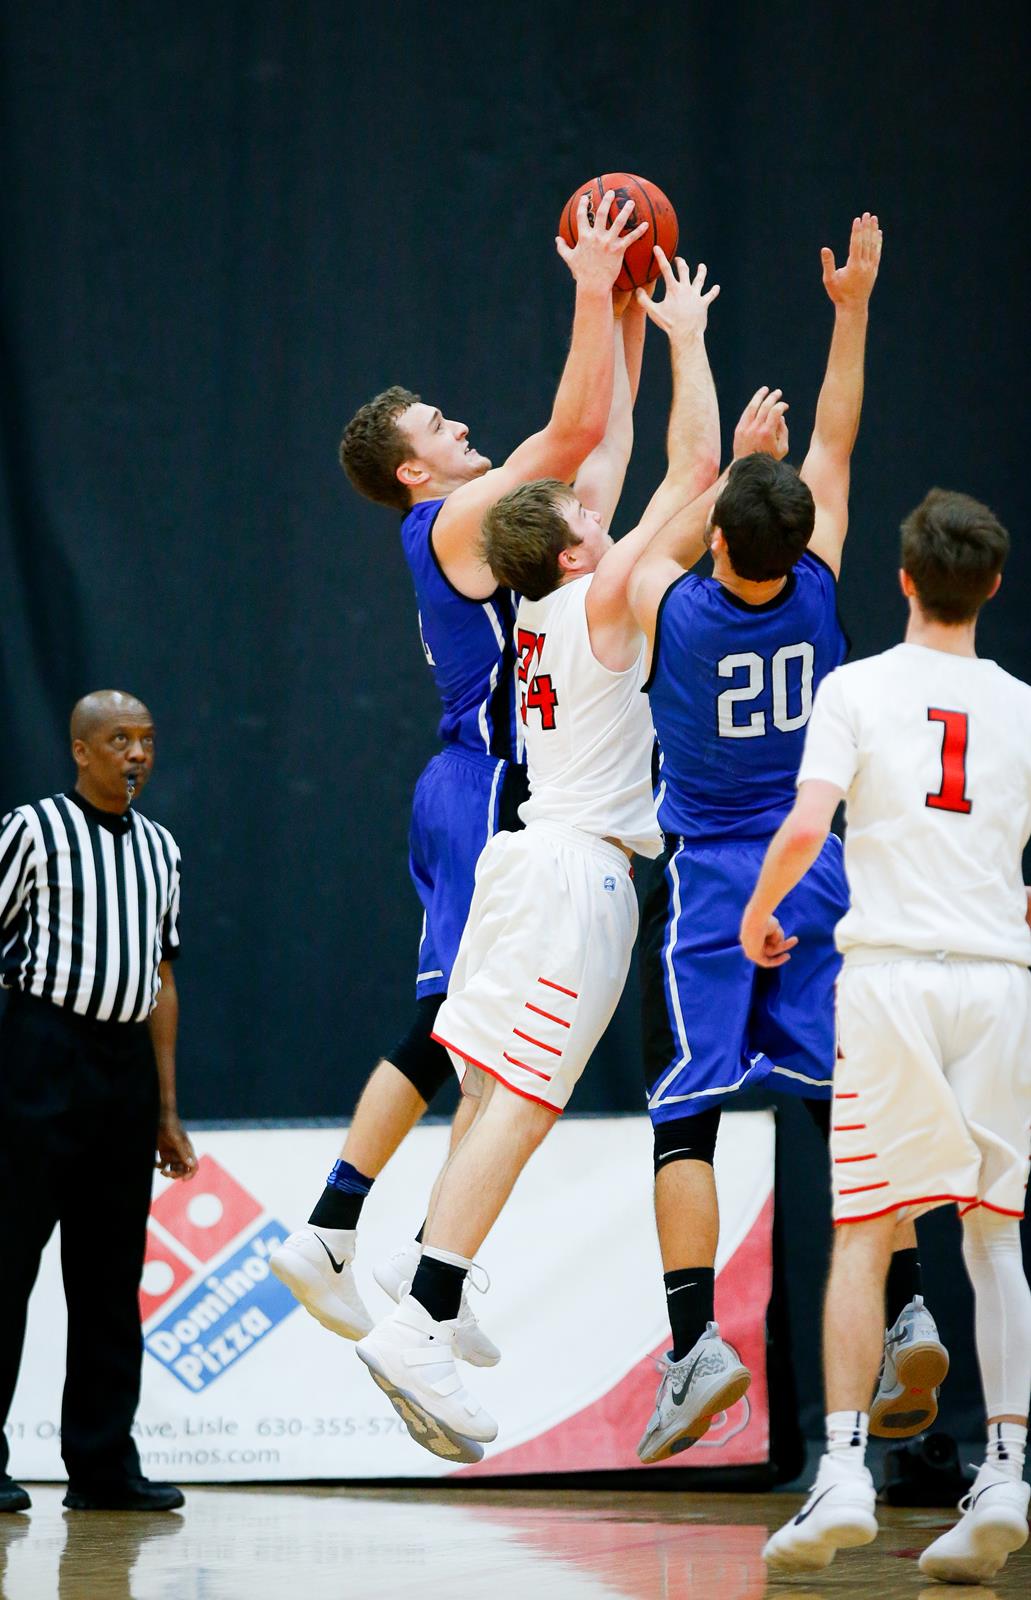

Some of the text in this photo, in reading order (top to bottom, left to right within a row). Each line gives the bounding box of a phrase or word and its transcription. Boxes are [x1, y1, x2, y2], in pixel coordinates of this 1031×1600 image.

[717, 641, 815, 738] 20
[925, 707, 973, 815] 1
[146, 1235, 284, 1362] Domino's
[171, 1305, 273, 1389] Pizza
[184, 1416, 239, 1436] Lisle
